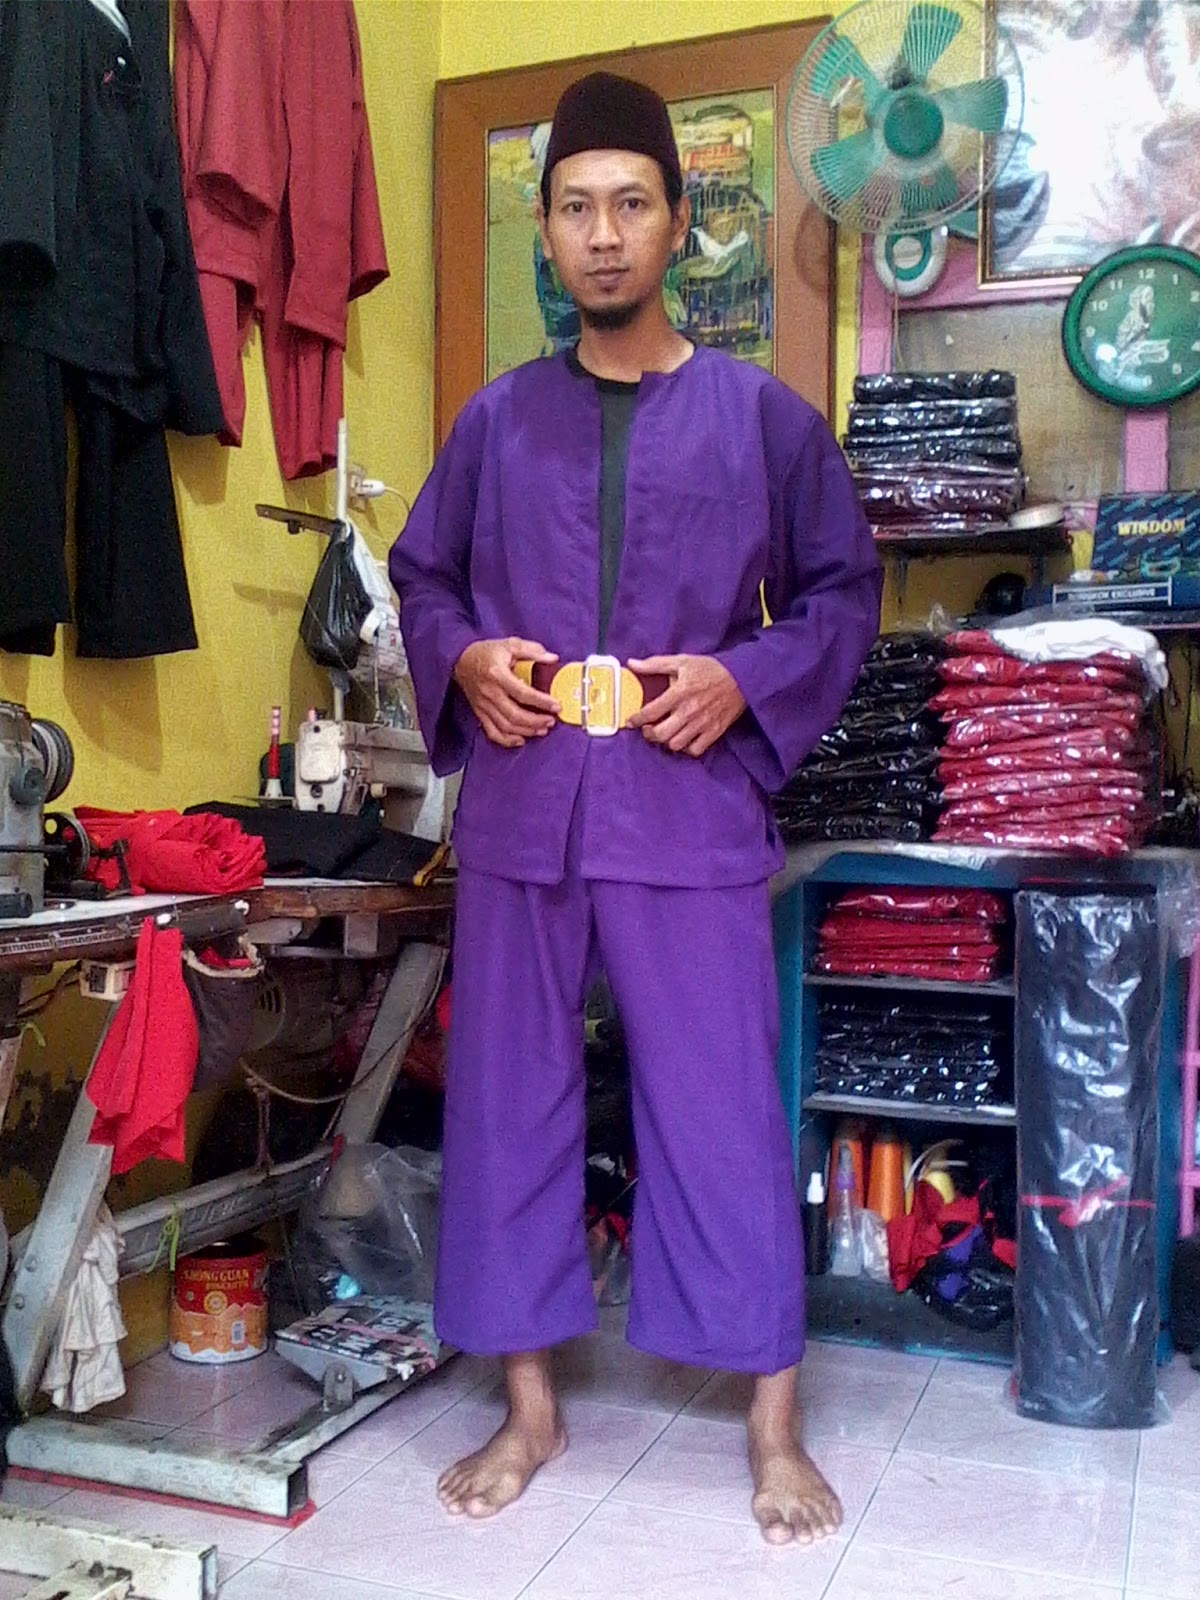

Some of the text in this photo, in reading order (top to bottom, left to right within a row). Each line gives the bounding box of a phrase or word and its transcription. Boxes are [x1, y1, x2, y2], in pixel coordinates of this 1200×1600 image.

[1139, 269, 1155, 279] 12
[1109, 278, 1124, 291] 11
[1092, 299, 1108, 311] 10
[1118, 519, 1185, 535] WISDOM
